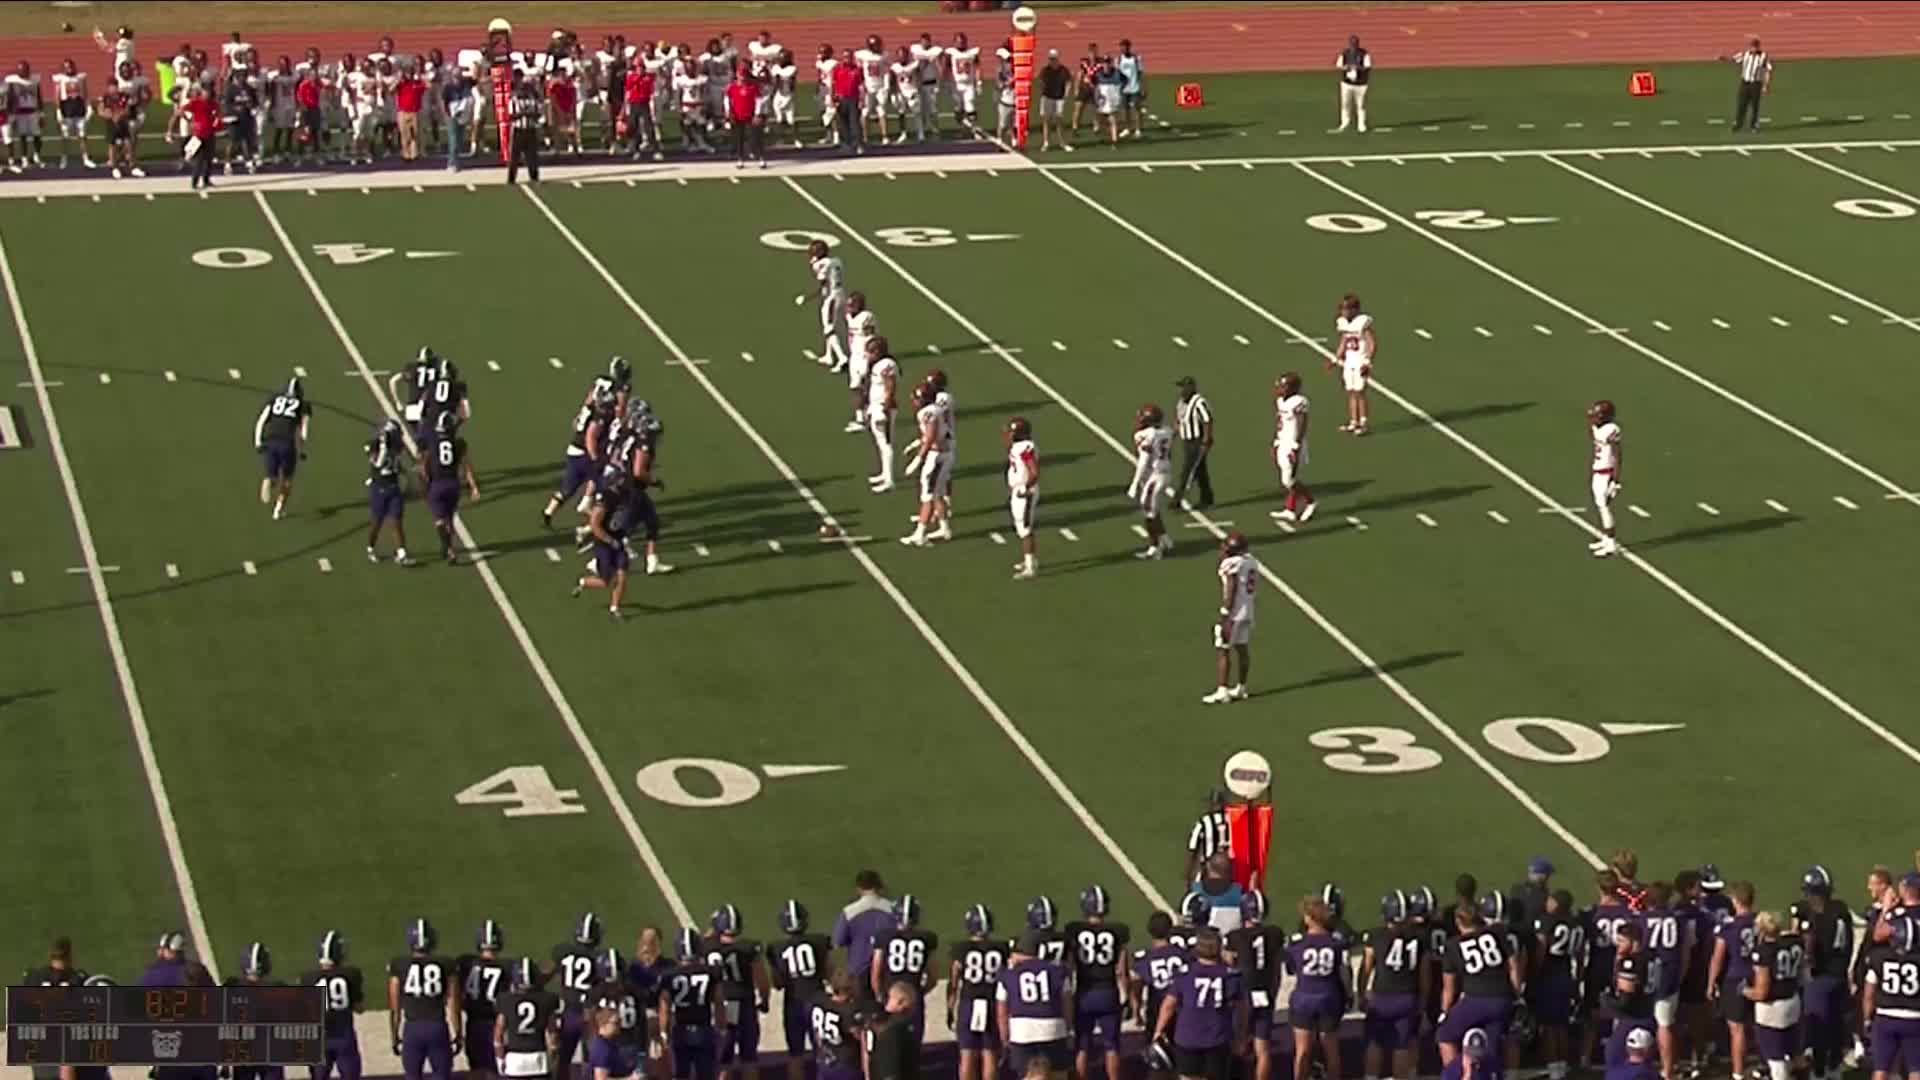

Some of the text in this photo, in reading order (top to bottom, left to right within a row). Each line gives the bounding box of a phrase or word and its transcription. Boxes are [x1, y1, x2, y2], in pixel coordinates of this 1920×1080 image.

[271, 395, 301, 418] 82
[435, 380, 450, 403] 0
[439, 441, 454, 466] 6
[1077, 930, 1115, 966] 83
[1549, 923, 1585, 957] 20
[1646, 916, 1678, 949] 70
[782, 942, 817, 978] 10
[888, 938, 927, 973] 86
[964, 949, 1003, 984] 89
[1252, 935, 1265, 970] 1
[1385, 937, 1420, 972] 41
[1458, 932, 1504, 975] 58
[404, 963, 443, 998] 48
[465, 965, 503, 1003] 47
[561, 954, 593, 990] 12
[1019, 970, 1050, 1003] 61
[1881, 961, 1920, 997] 53
[672, 973, 711, 1008] 27
[1194, 977, 1224, 1008] 71
[516, 1001, 537, 1035] 2
